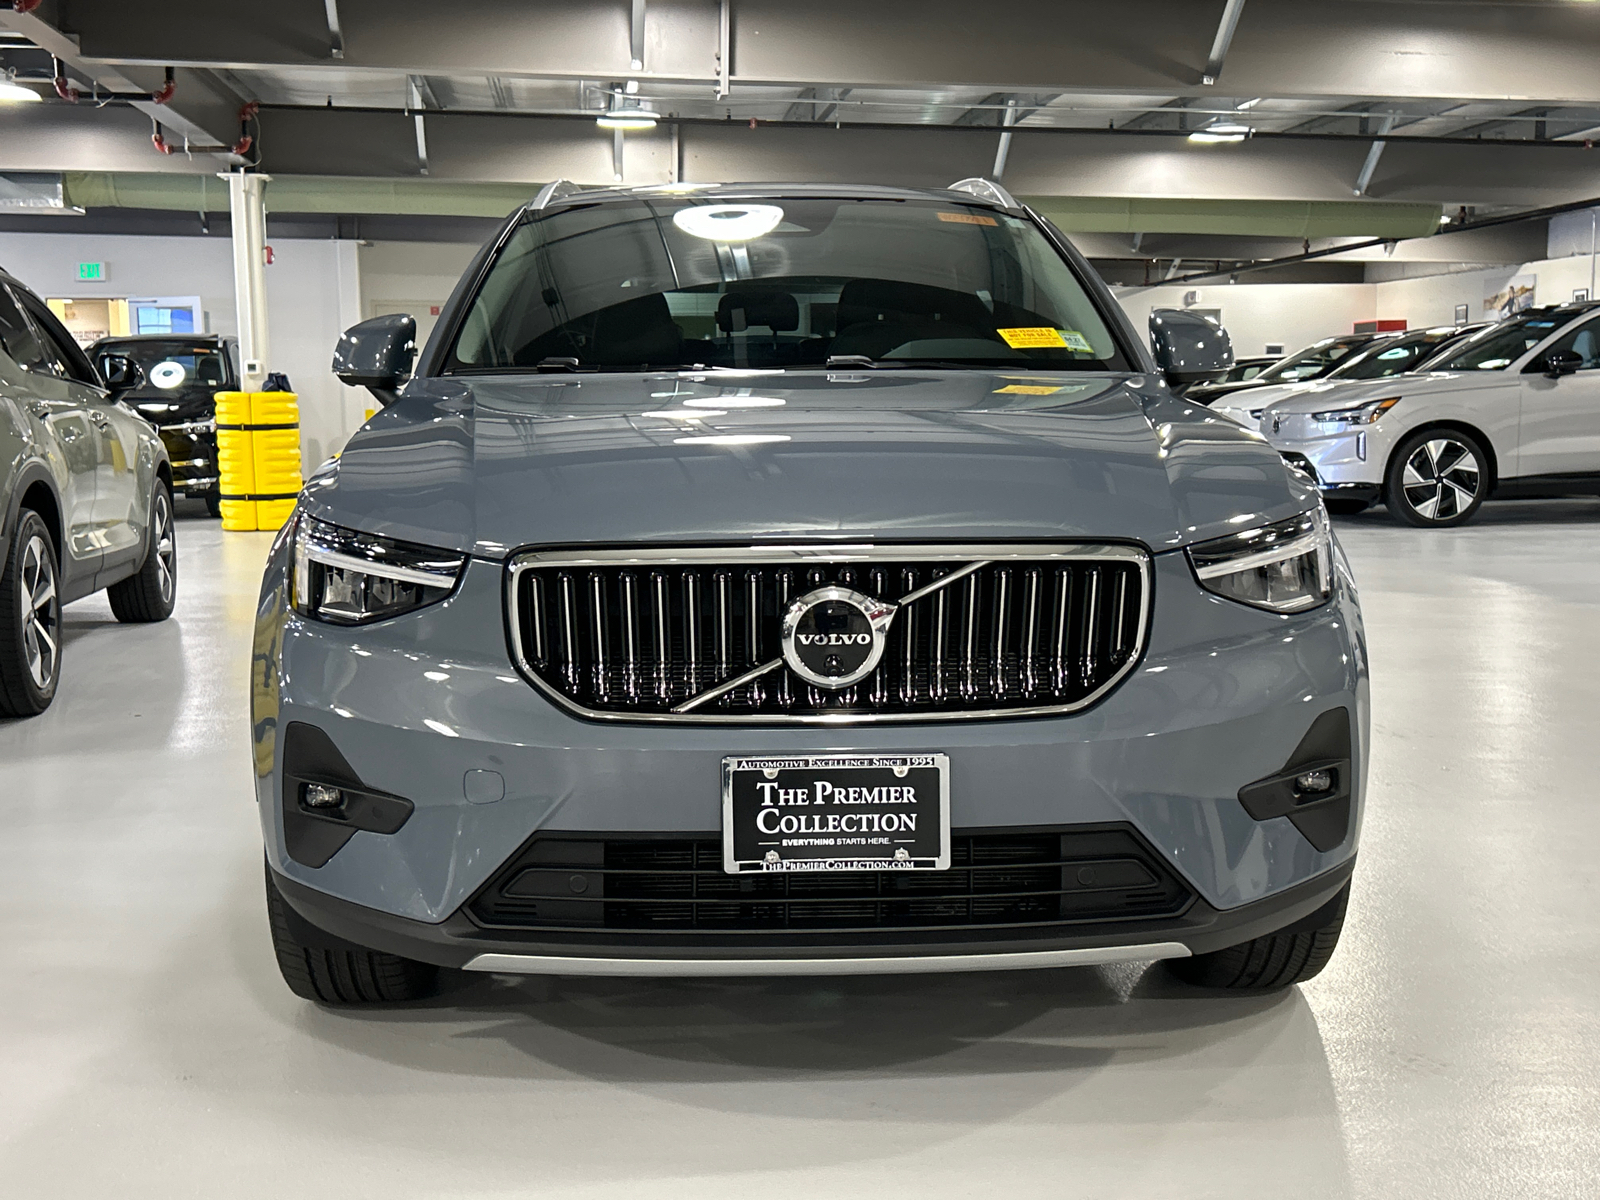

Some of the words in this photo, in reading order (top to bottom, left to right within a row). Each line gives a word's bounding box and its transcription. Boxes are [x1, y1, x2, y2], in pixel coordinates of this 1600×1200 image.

[80, 263, 100, 278] EXIT
[796, 633, 871, 645] VOLVO
[740, 760, 805, 769] AUTOMOTIVE
[808, 759, 870, 768] EXCELLENCE
[872, 758, 902, 766] SINCE
[906, 757, 933, 766] 1995
[756, 781, 809, 806] THE
[813, 780, 917, 805] PREMIER
[756, 808, 917, 834] COLLECTION
[782, 838, 834, 846] EVERYTHING
[836, 837, 866, 845] STARTS
[760, 860, 915, 871] THEPREMIERCOLLECTION.COM
